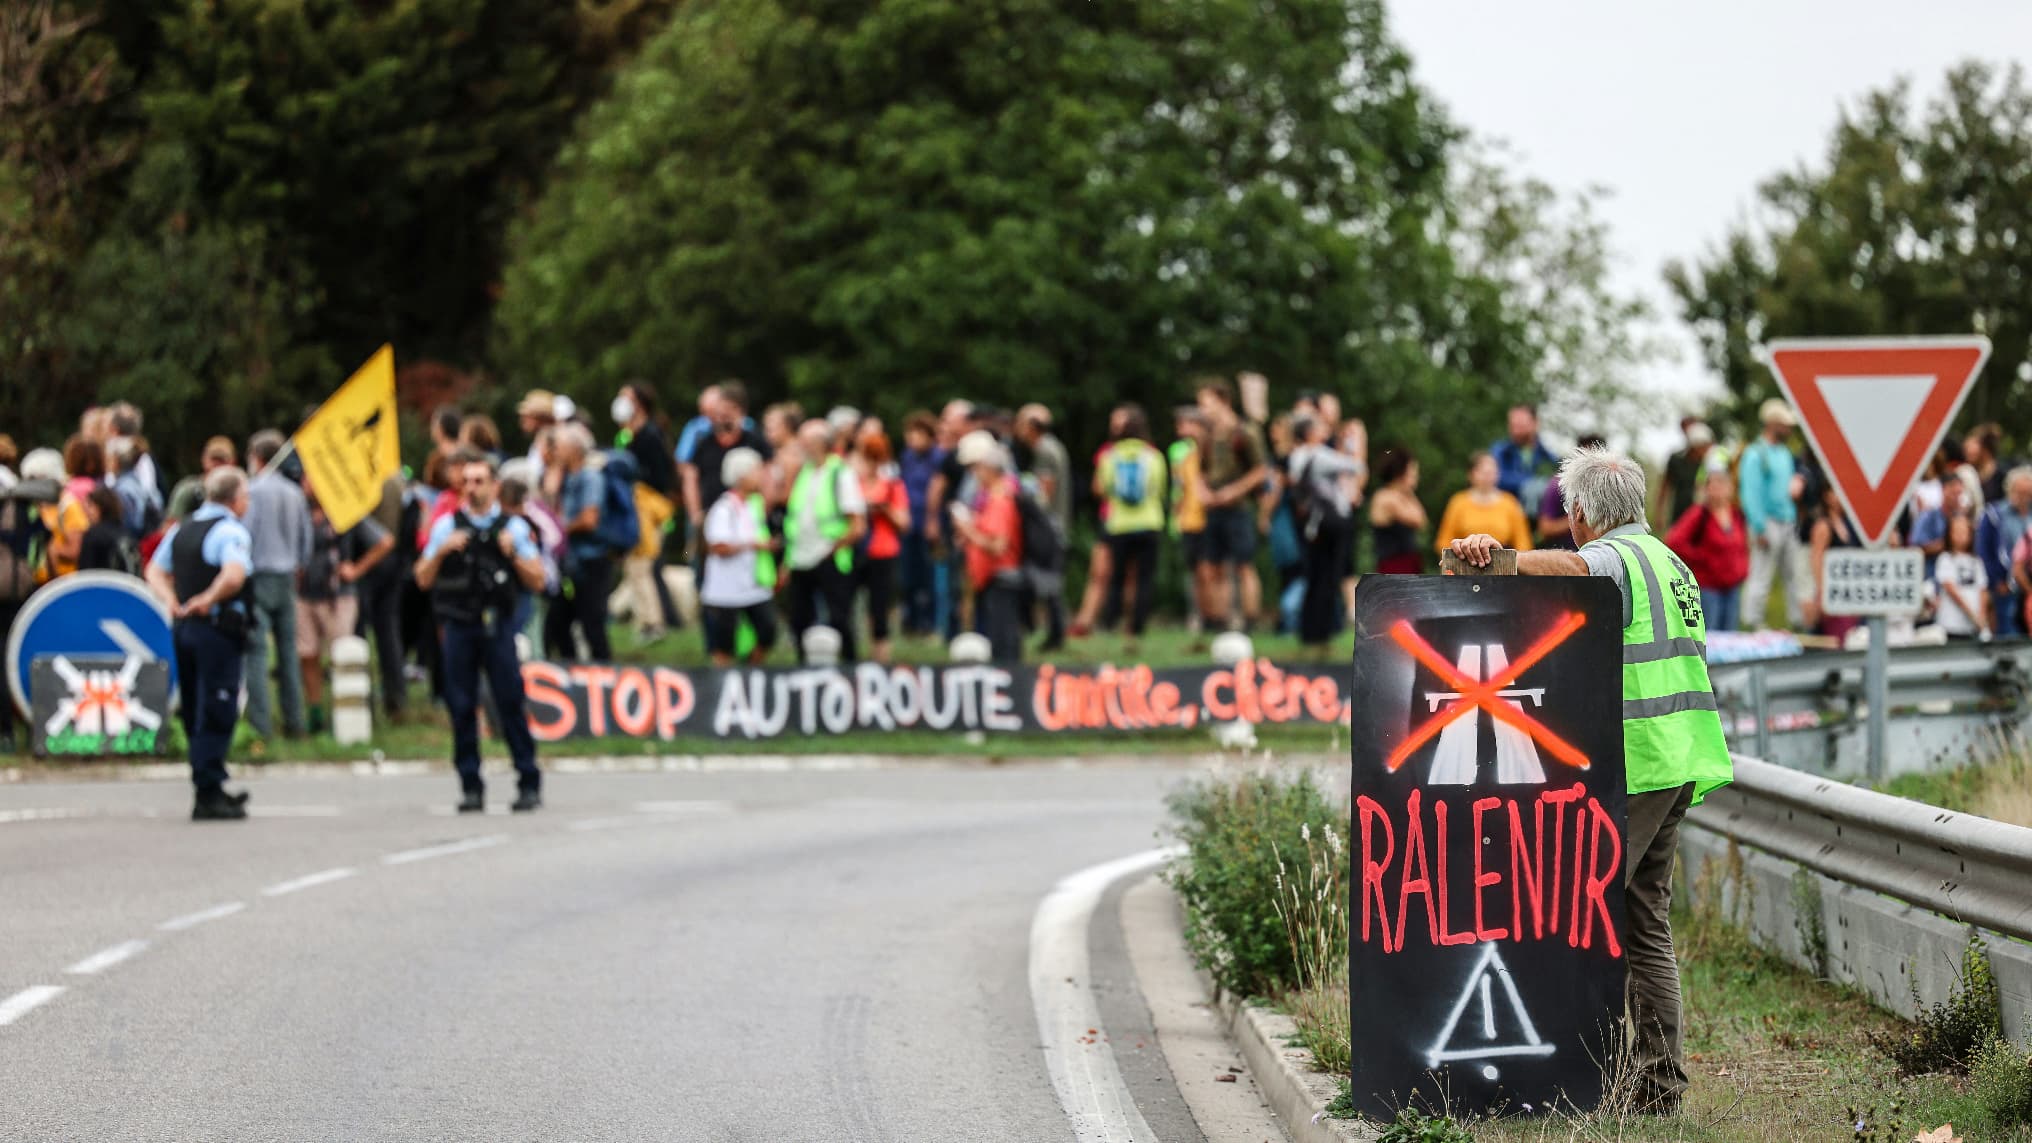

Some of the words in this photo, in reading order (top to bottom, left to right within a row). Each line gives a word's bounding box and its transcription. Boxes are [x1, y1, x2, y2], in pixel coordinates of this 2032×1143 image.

[1829, 558, 1888, 578] CÉDEZ
[1894, 561, 1914, 578] LE
[1829, 585, 1914, 602] PASSAGE
[520, 661, 695, 741] STOP
[713, 662, 1023, 738] AUTOROUTE
[1356, 782, 1622, 958] RALENTIR
